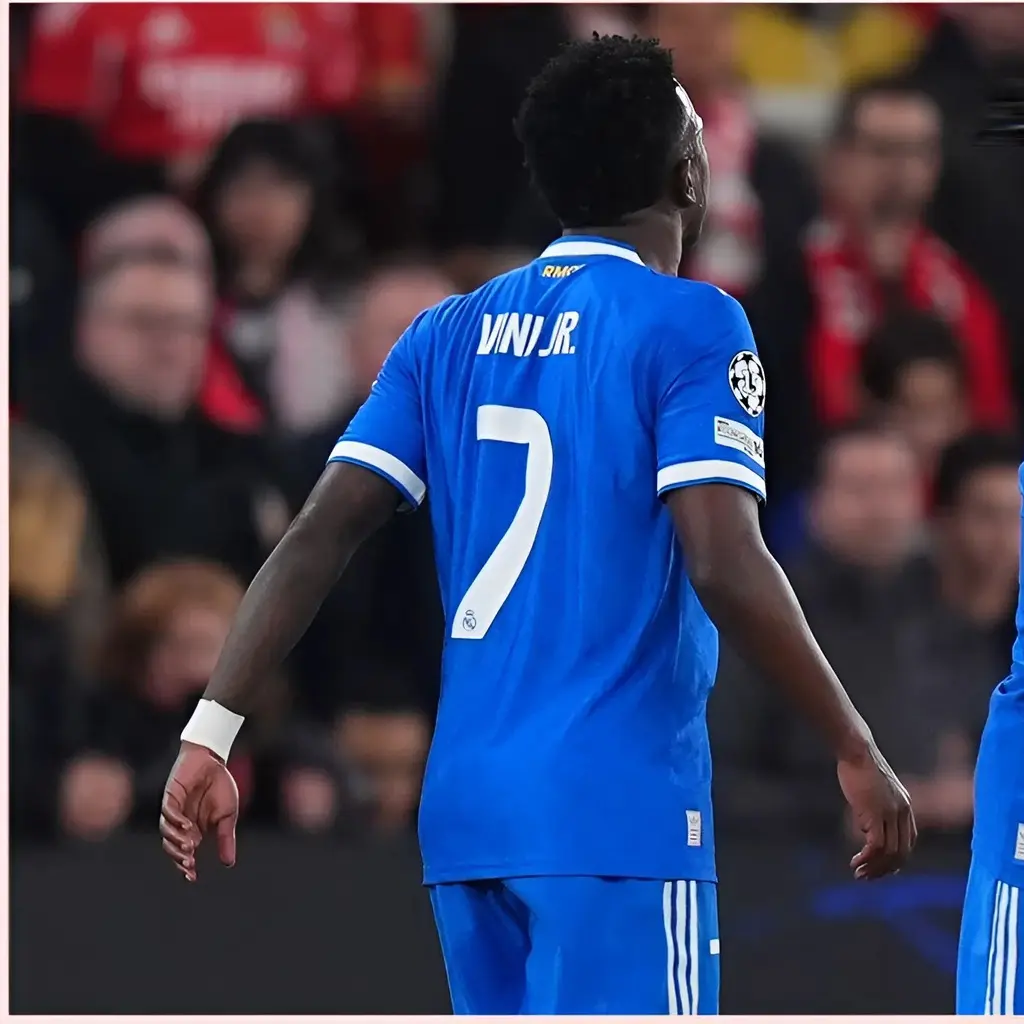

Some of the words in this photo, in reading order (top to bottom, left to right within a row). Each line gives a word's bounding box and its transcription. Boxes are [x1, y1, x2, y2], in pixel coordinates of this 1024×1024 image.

[477, 312, 545, 357] VINI
[538, 311, 580, 357] JR.
[451, 404, 554, 640] 7
